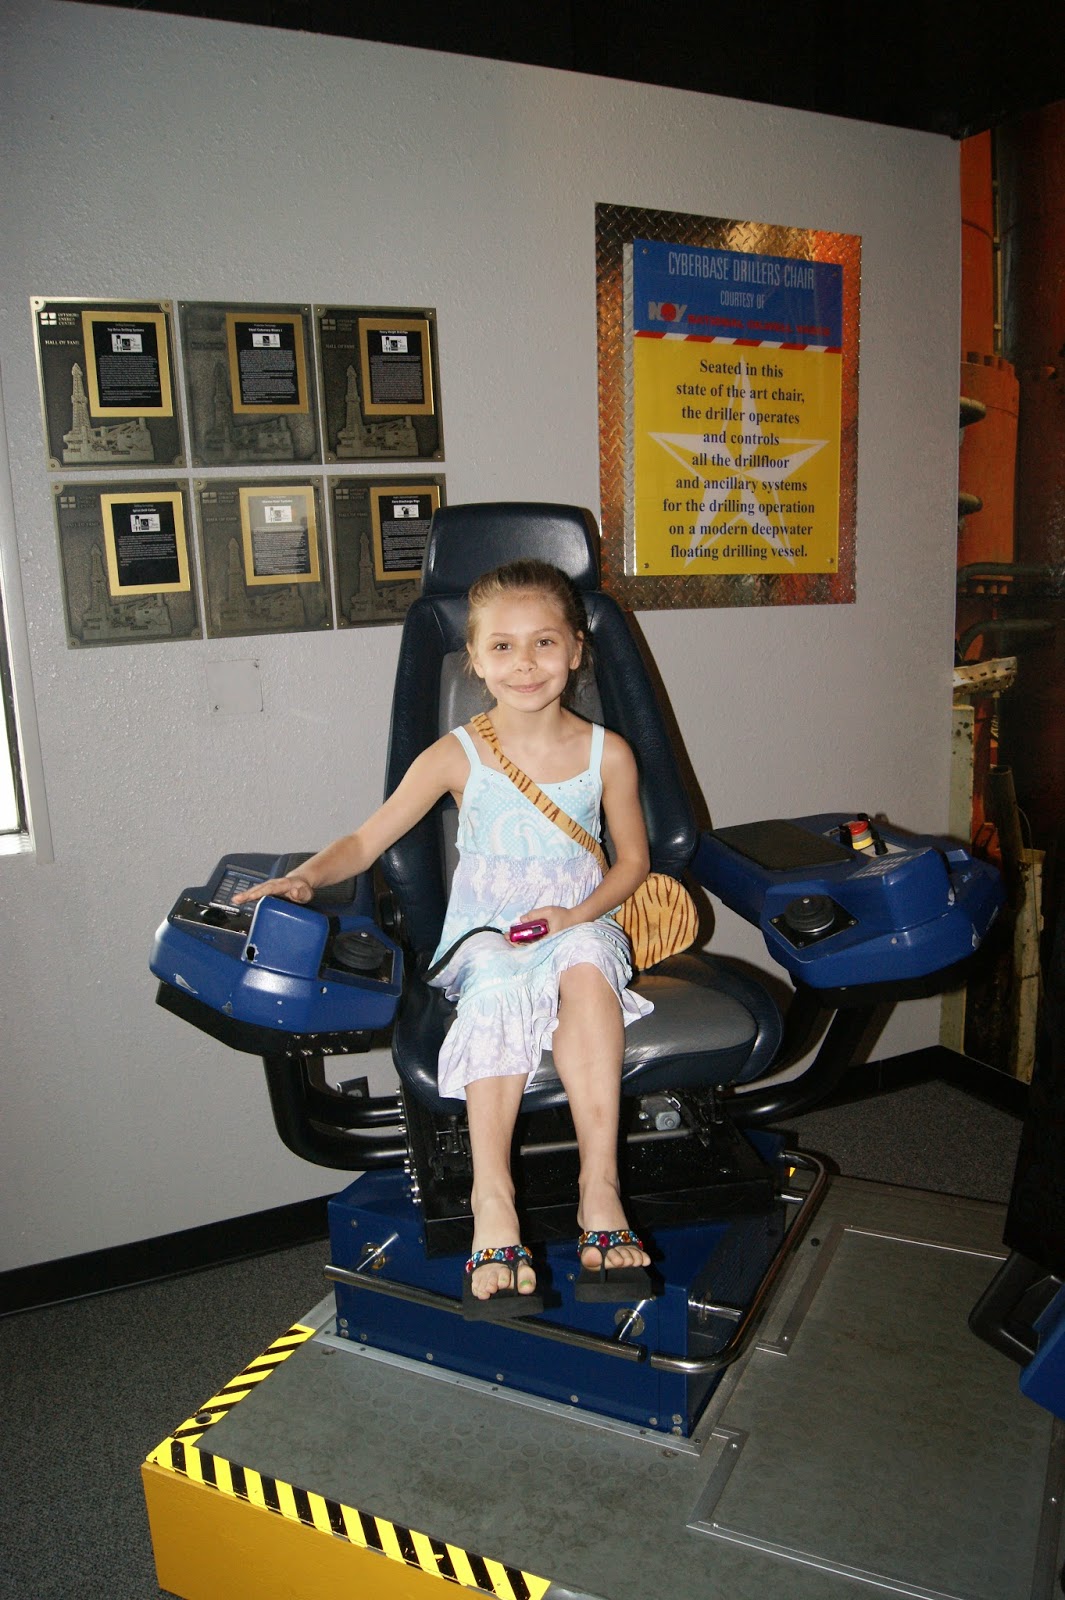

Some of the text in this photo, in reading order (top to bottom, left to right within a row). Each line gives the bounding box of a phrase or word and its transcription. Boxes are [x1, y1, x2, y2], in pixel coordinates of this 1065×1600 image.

[668, 251, 814, 290] CYBERBASE DRILLERS CHAIR
[720, 290, 766, 309] COURTESY OF
[700, 359, 784, 378] Seated in this
[676, 383, 805, 404] state of the art chair,
[682, 406, 800, 426] the driller operates
[703, 430, 780, 446] and controls
[692, 453, 790, 468] all the drillfloor
[676, 476, 808, 494] and ancillary systems
[663, 499, 815, 516] for the drilling operation
[669, 522, 813, 538] on a modern deepwater
[671, 545, 808, 561] floating drilling vessel.
